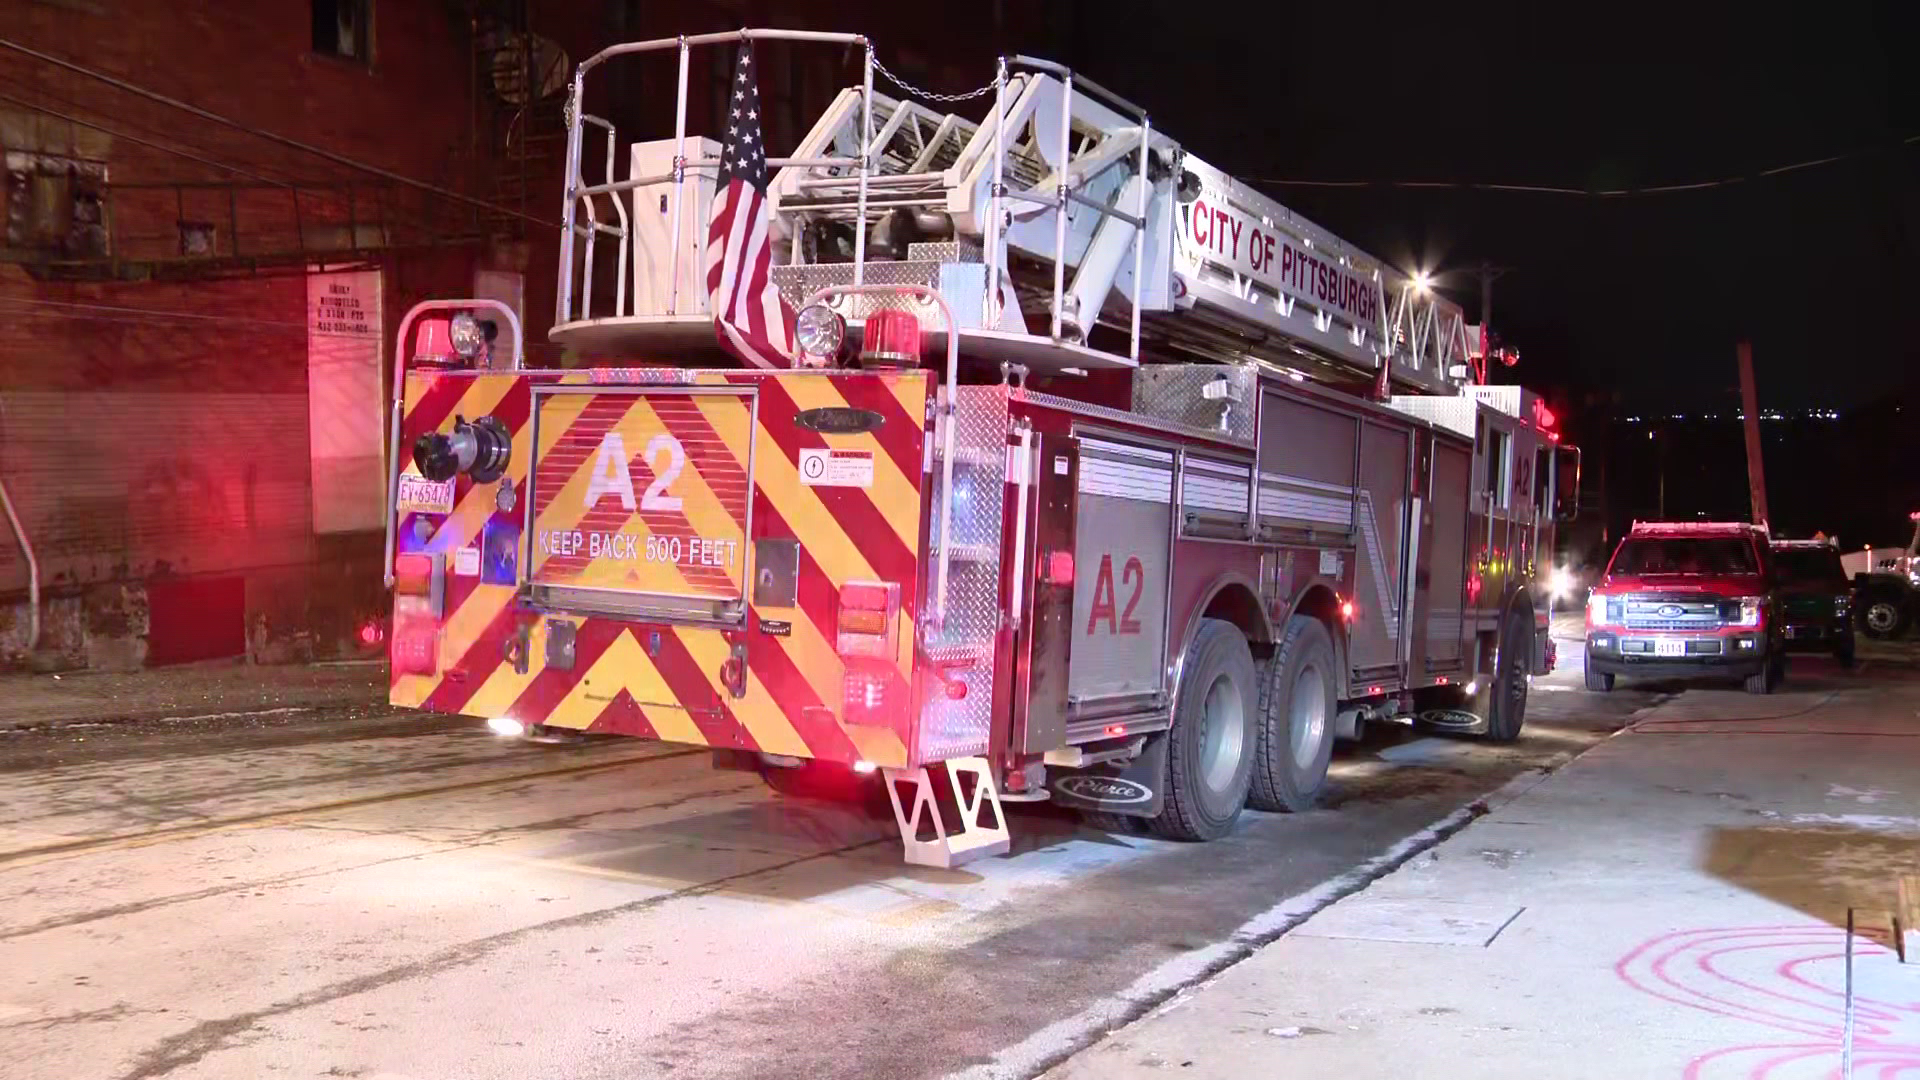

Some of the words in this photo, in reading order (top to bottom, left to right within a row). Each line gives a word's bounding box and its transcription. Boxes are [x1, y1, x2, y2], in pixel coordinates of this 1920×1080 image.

[1193, 200, 1242, 260] CITY
[1250, 228, 1275, 274] OF
[1282, 243, 1377, 324] PITTSBURGH
[583, 432, 685, 511] A2
[1514, 455, 1530, 496] A2
[540, 530, 583, 556] KEEP
[589, 533, 638, 560] BACK
[645, 536, 682, 563] 500
[689, 537, 737, 567] FEET
[1087, 554, 1144, 635] A2
[1073, 778, 1136, 797] Pierce
